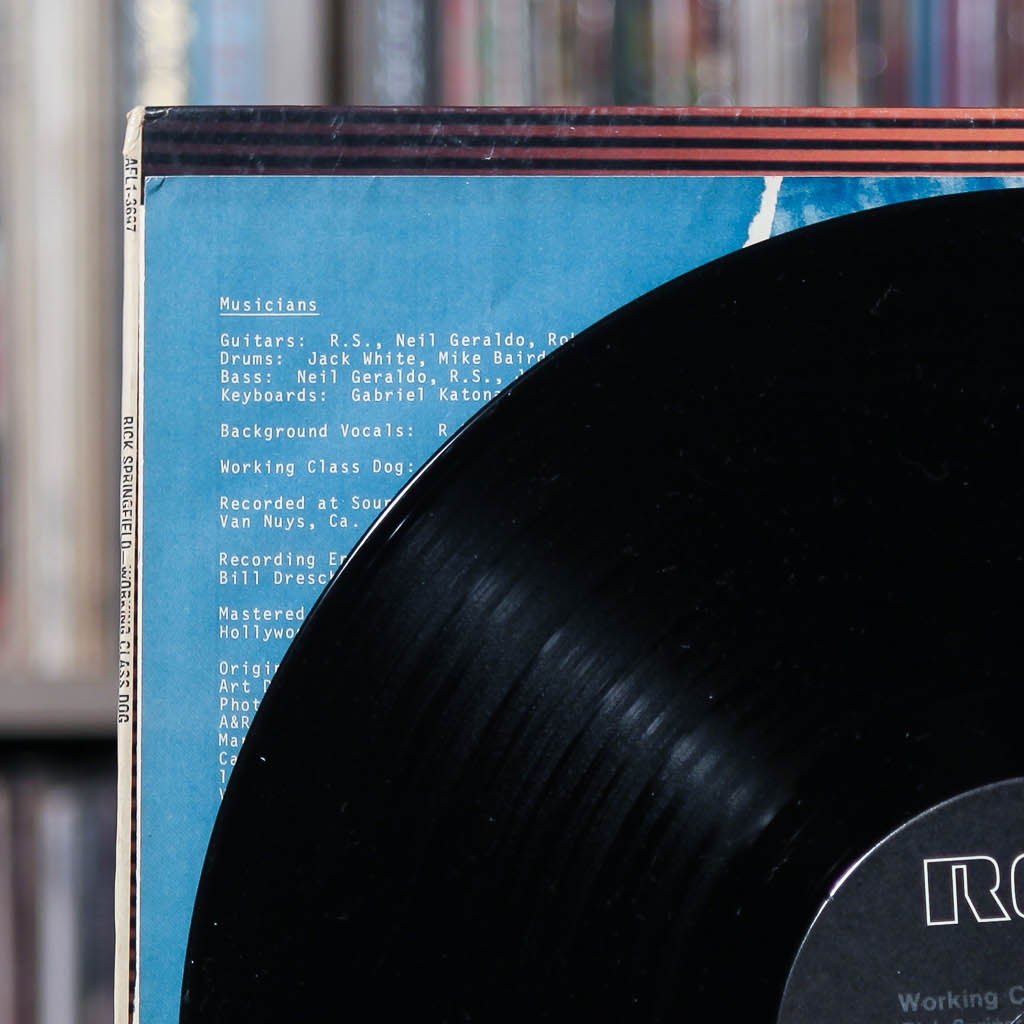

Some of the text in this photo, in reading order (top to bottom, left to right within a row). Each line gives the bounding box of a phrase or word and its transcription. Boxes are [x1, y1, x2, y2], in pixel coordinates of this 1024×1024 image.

[219, 297, 318, 313] Musicians
[219, 332, 305, 348] Guitars:
[329, 333, 383, 350] R.S.,
[395, 332, 436, 348] Neil
[449, 331, 536, 349] Geraldo,
[219, 350, 284, 366] Drums:
[307, 350, 351, 366] Jack
[362, 349, 426, 368] White,
[438, 350, 482, 366] Mike
[220, 368, 273, 385] Bass:
[297, 368, 338, 384] Neil
[351, 368, 437, 386] Geraldo,
[449, 368, 502, 385] R.S.,
[220, 386, 327, 405] Keyboards:
[351, 386, 425, 402] Gabriel
[219, 422, 329, 442] Background
[339, 422, 414, 439] Vocals:
[219, 458, 415, 477] Working Class Dog:
[219, 494, 305, 511] Recorded
[317, 496, 339, 511] at
[219, 512, 359, 531] Van Nuys, Ca.
[219, 551, 316, 570] Recording
[219, 570, 260, 586] Bill
[218, 606, 305, 621] Mastered
[218, 678, 251, 694] Art
[117, 693, 130, 725] DOG
[218, 714, 251, 730] A&R
[897, 989, 999, 1014] Working
